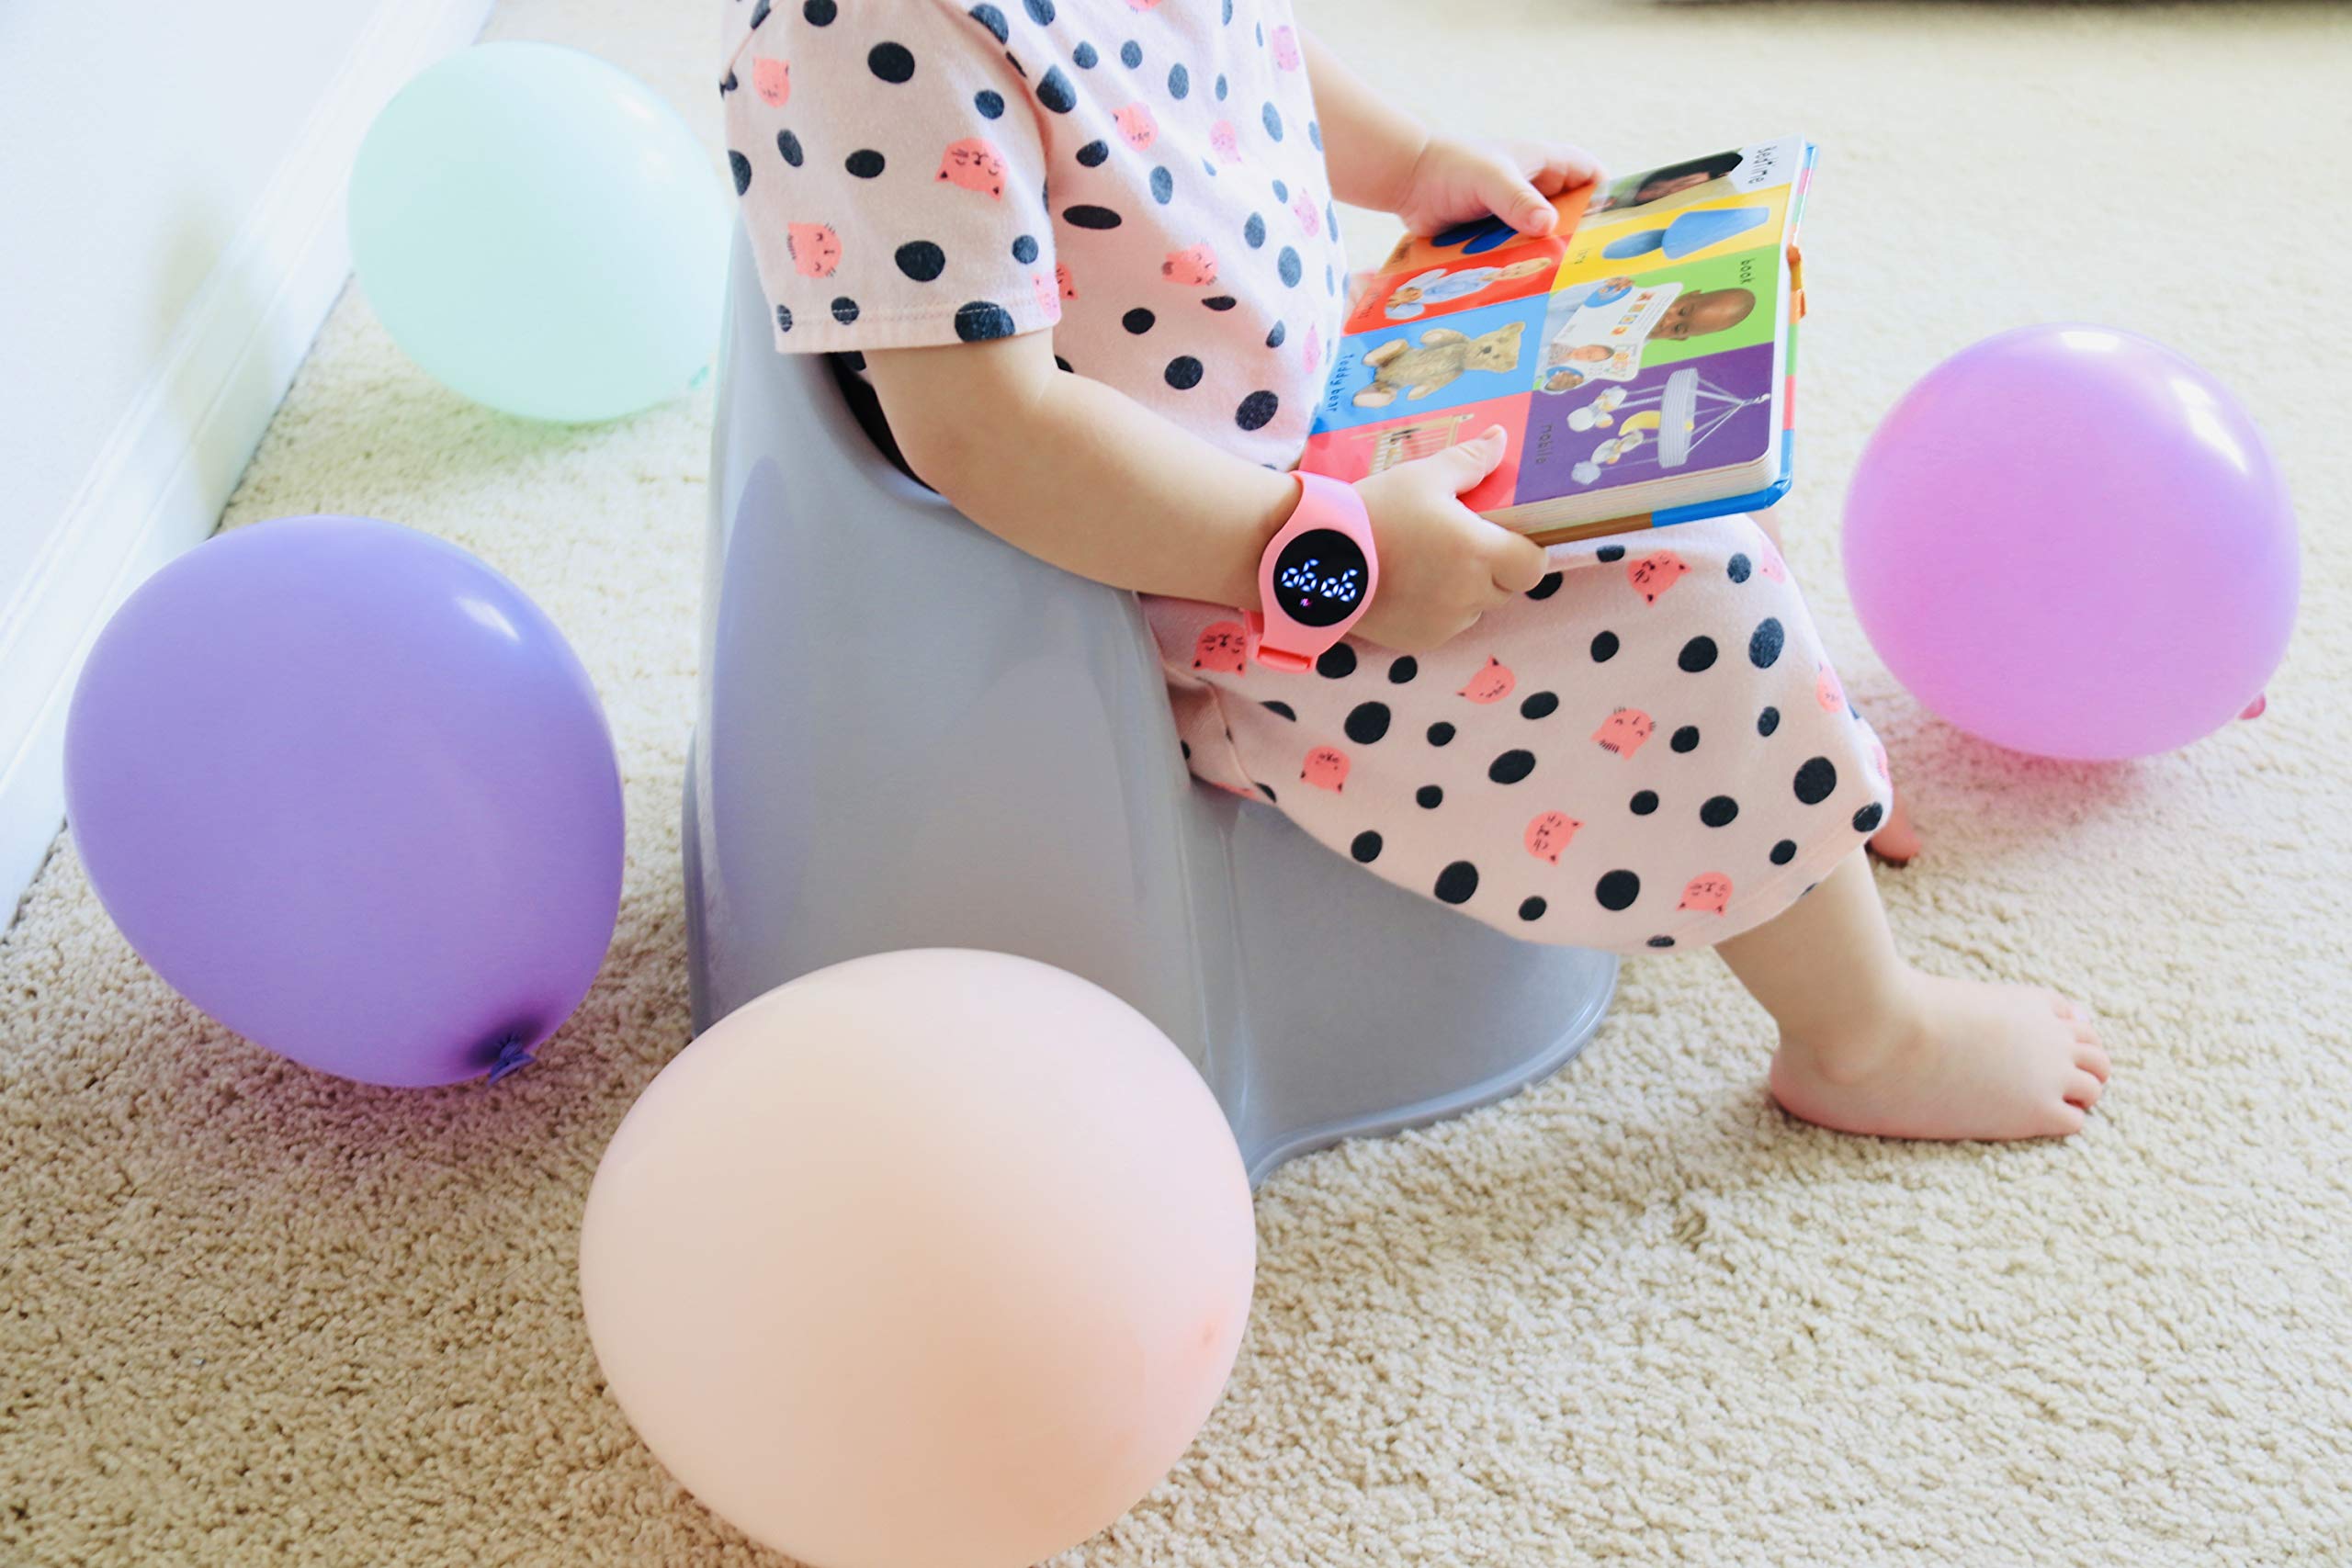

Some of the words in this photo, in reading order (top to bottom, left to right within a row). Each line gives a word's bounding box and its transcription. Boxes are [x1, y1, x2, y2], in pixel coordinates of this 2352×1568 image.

[1739, 256, 1758, 286] book
[1329, 353, 1356, 387] teddy
[1325, 386, 1347, 413] bear
